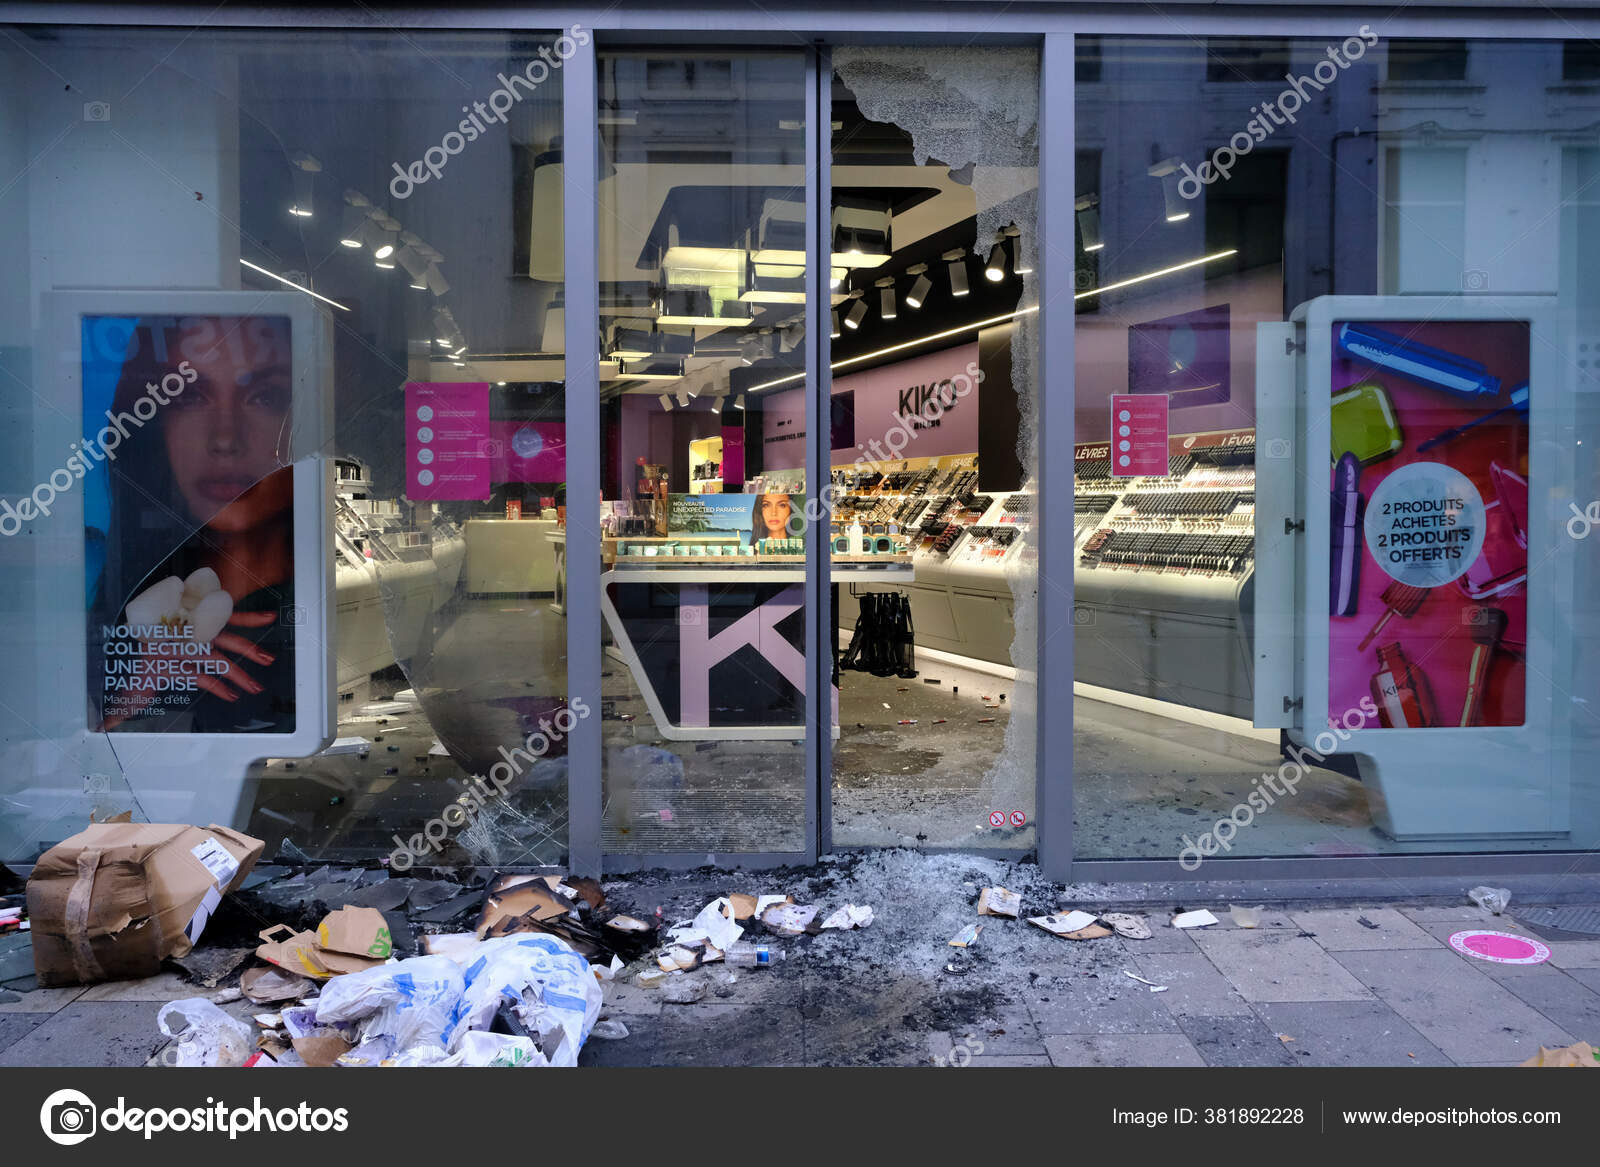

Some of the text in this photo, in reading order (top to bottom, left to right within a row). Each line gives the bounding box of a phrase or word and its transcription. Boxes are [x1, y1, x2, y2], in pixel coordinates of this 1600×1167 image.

[898, 378, 959, 416] KIKO
[913, 418, 941, 430] MILNO
[1382, 498, 1464, 515] 2 PRODUITS
[1391, 511, 1456, 530] ACHETÉS
[1377, 528, 1471, 548] 2 PRODUITS
[103, 625, 194, 639] NOUVELLE
[103, 642, 211, 656] COLLECTION
[104, 659, 230, 674] UNEXPECTED
[104, 676, 198, 691] PARADISE
[104, 694, 191, 706] Maquillage d'été
[104, 706, 166, 716] sans limites
